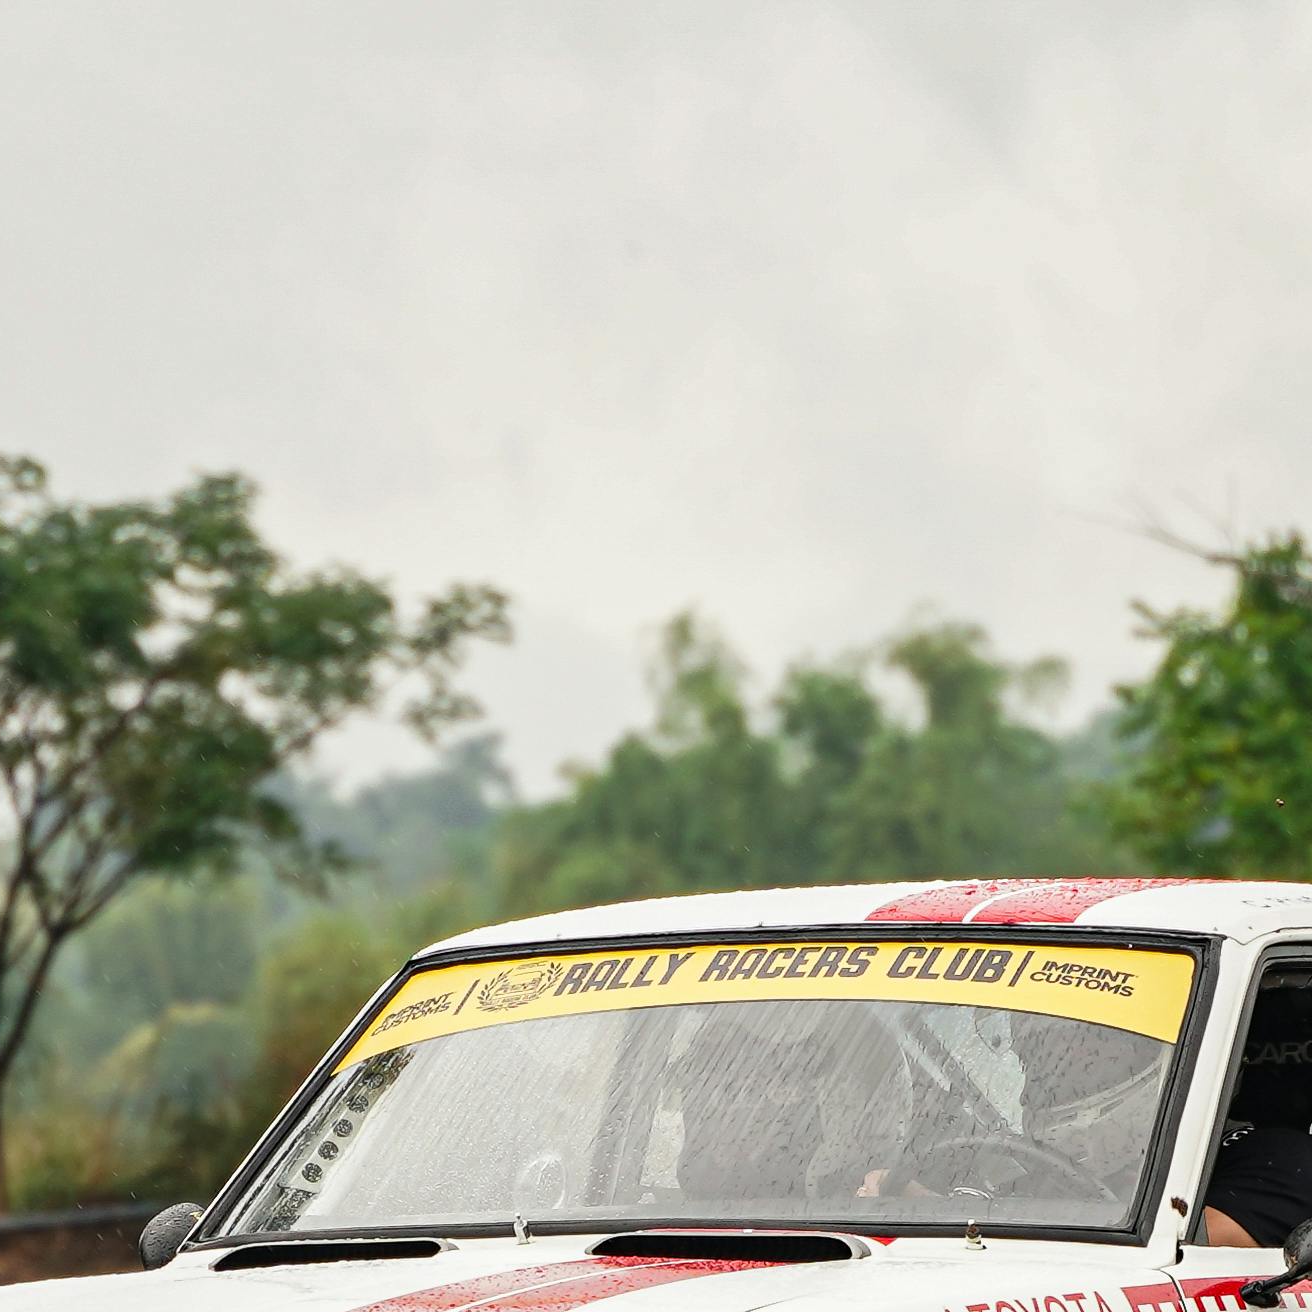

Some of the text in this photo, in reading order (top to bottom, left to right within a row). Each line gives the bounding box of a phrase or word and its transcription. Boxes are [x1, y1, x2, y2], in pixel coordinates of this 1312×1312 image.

[553, 946, 1014, 997] RALLY RACERS CLUB
[1030, 971, 1135, 997] CUSTOMS
[1041, 961, 1135, 984] IMPRINT
